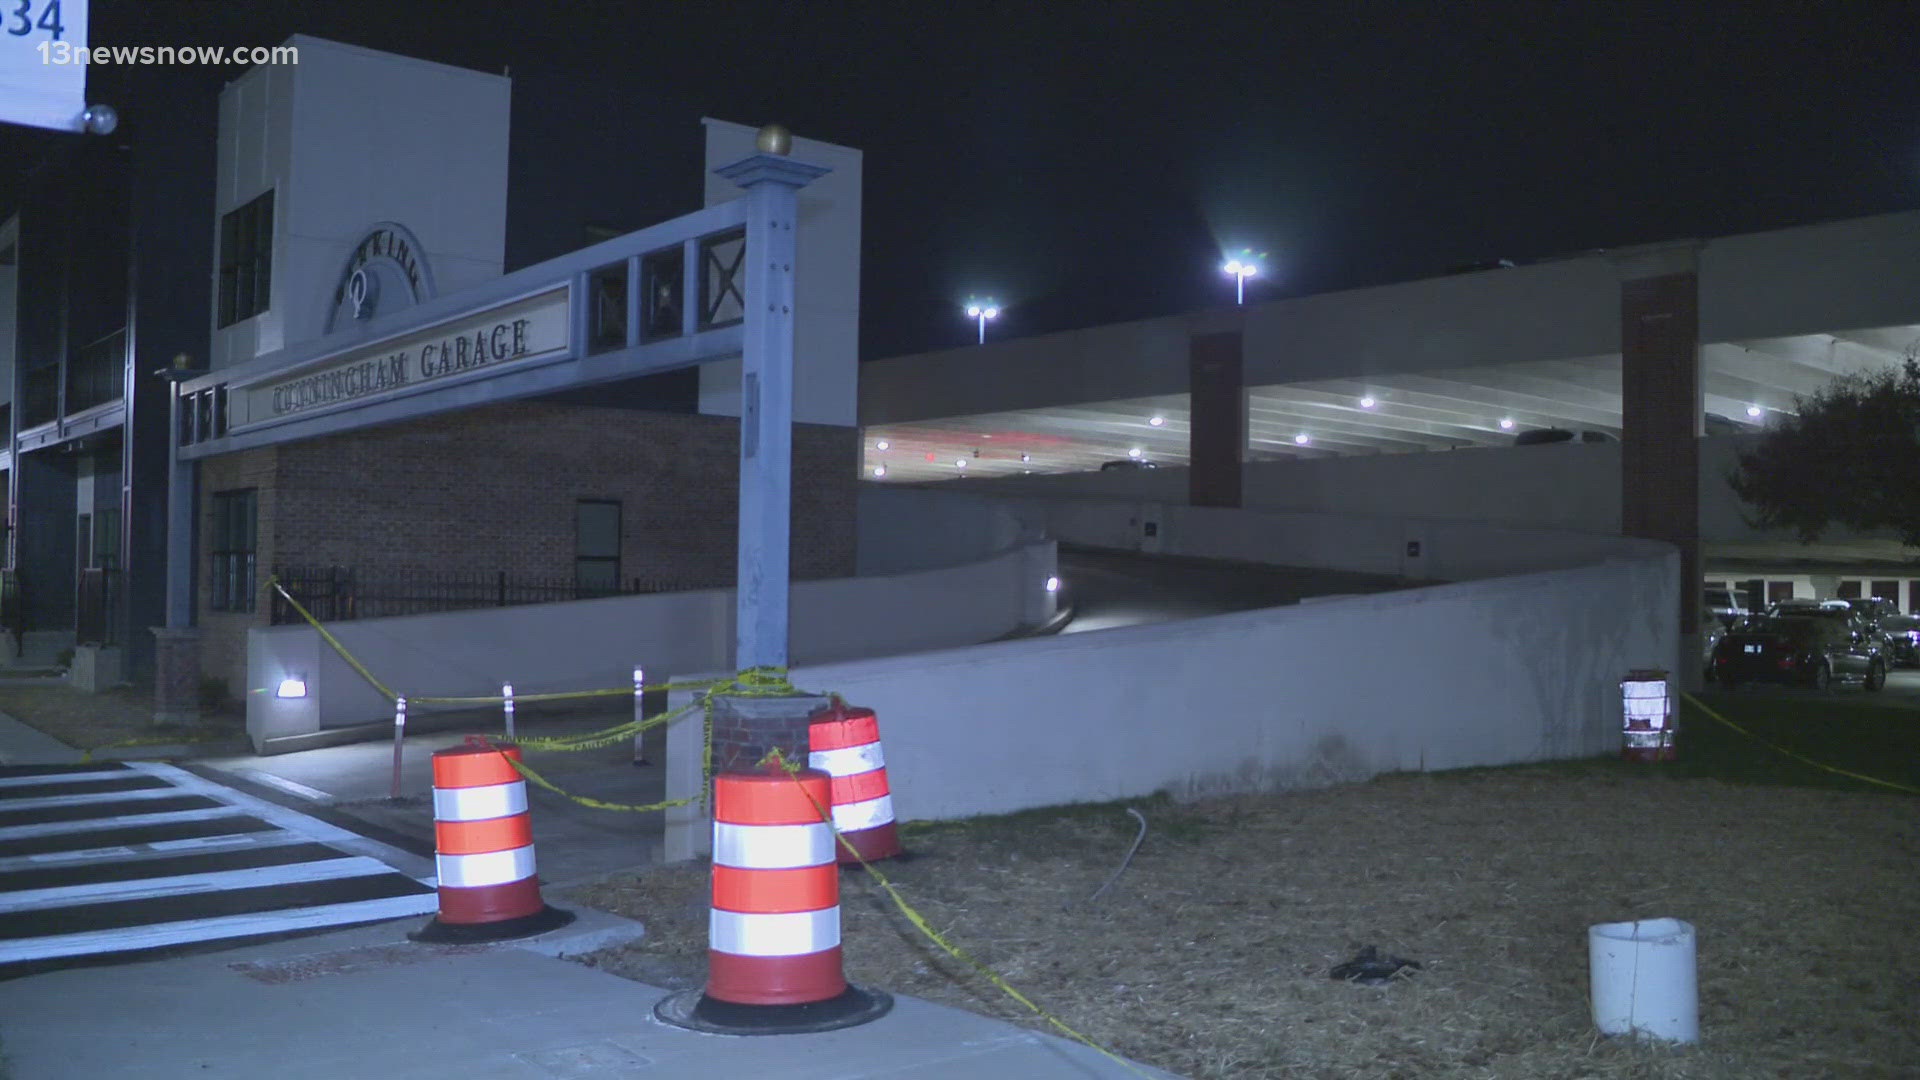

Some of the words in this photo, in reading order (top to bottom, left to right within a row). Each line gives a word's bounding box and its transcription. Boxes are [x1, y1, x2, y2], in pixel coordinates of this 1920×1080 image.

[0, 0, 64, 41] 34
[336, 230, 418, 305] RKING
[420, 319, 527, 378] GARAGE
